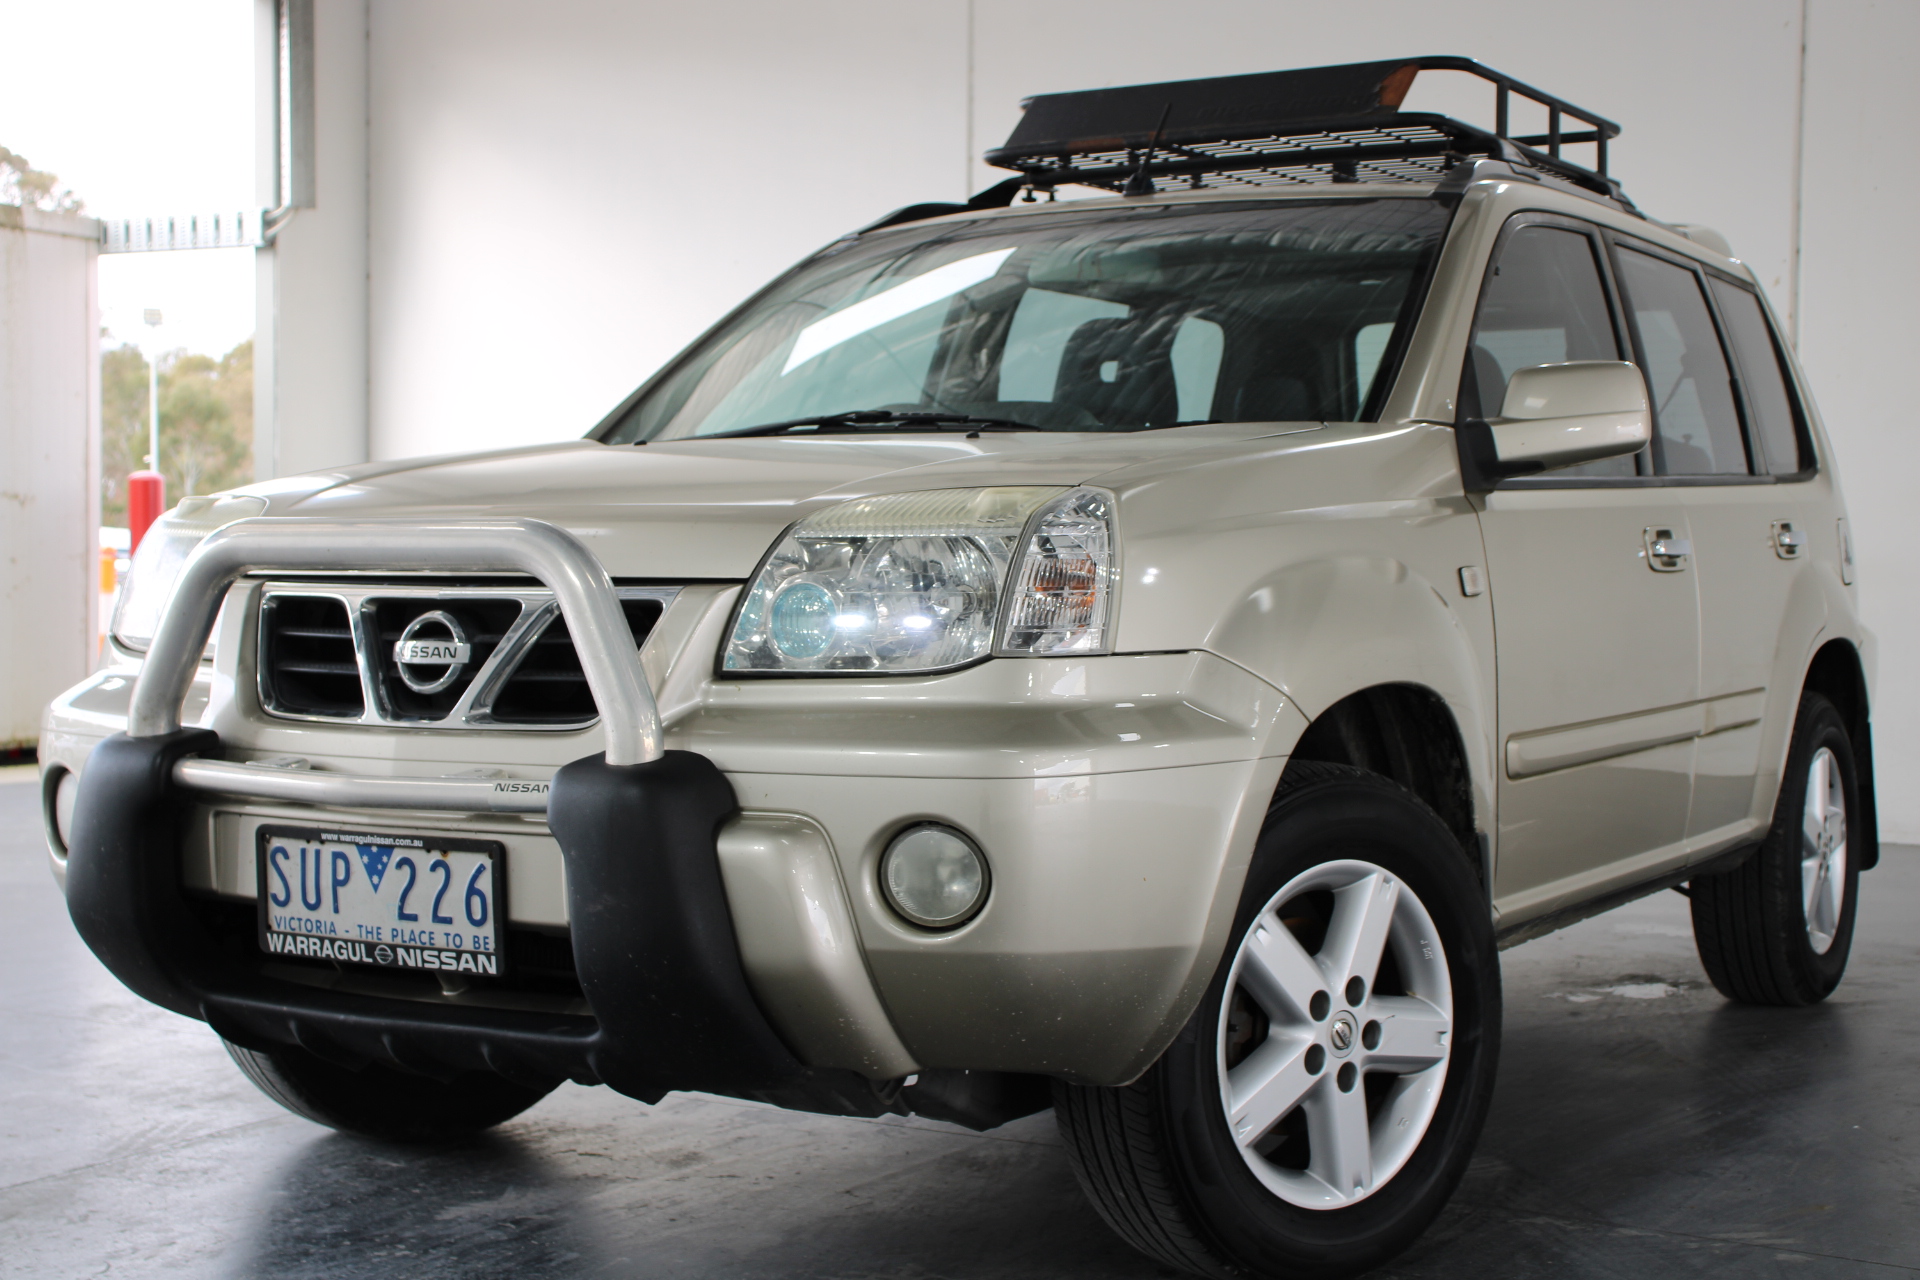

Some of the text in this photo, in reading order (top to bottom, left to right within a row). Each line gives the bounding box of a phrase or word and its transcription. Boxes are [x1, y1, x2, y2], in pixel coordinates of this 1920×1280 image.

[400, 646, 458, 659] SSAN
[494, 783, 549, 793] NISSAN
[321, 832, 423, 848] wwwwarragulnissan.com.au
[269, 845, 488, 928] SUP 226
[274, 914, 337, 936] VICTORIA
[357, 924, 383, 942] THE
[391, 928, 436, 947] PLACE
[443, 932, 463, 949] TO
[473, 935, 490, 951] BE
[266, 932, 497, 975] WARRAGUL NISSAN
